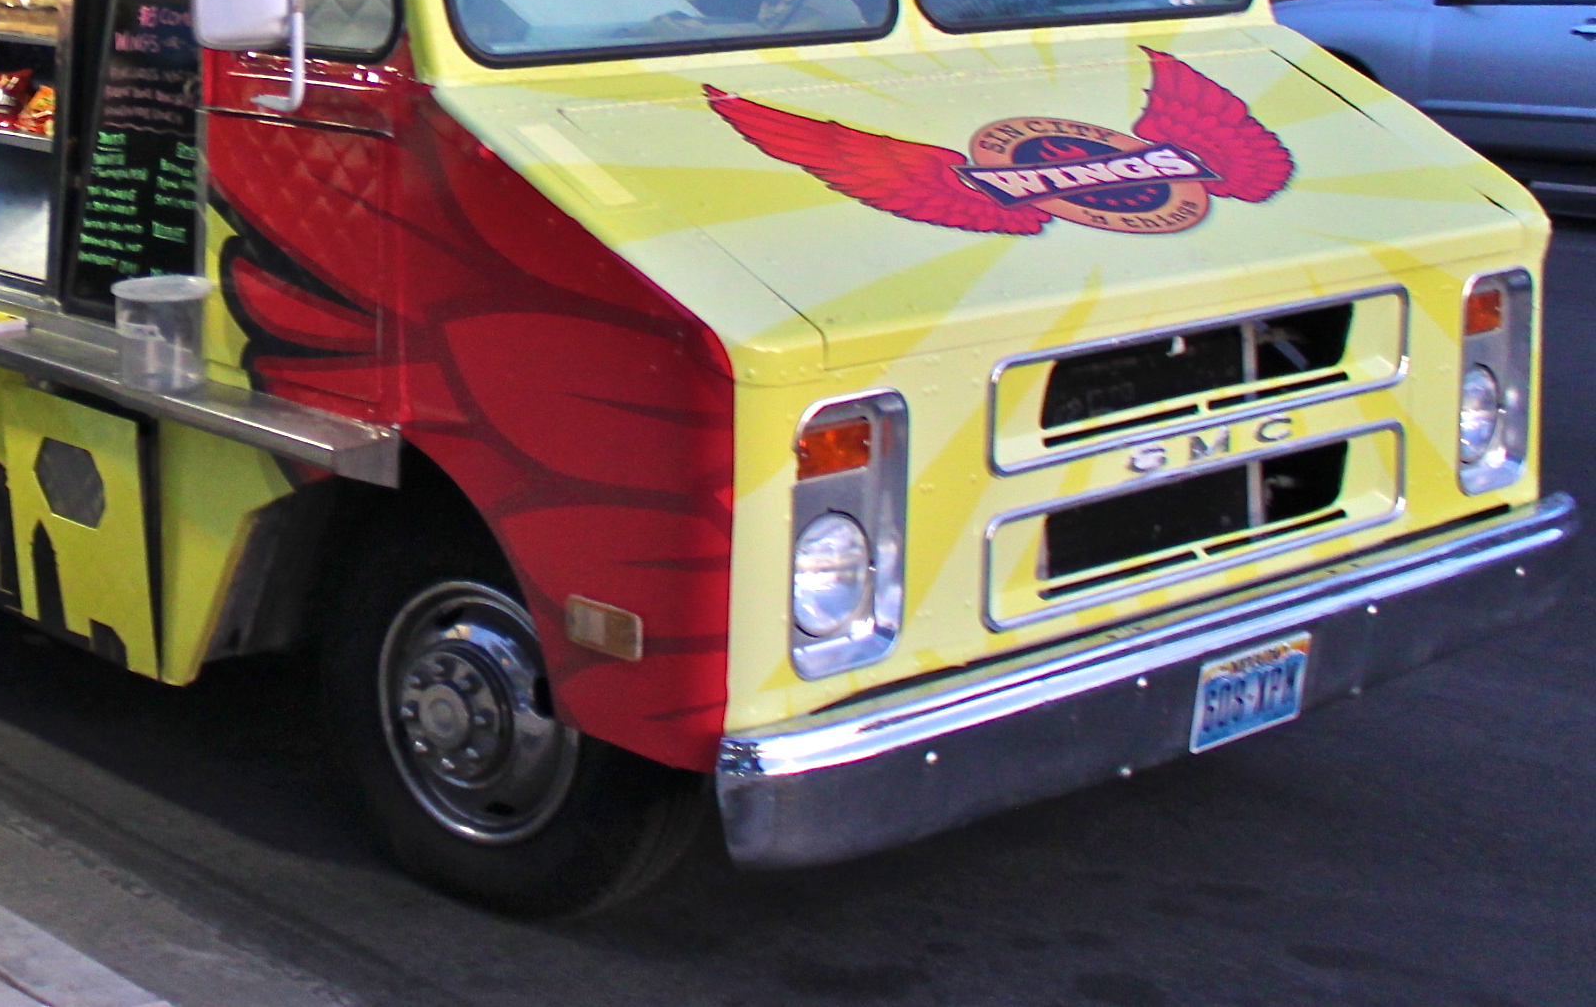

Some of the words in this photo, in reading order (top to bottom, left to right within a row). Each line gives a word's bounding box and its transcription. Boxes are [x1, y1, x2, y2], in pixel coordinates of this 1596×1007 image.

[979, 124, 1024, 154] SIN
[1026, 120, 1117, 143] CITY
[970, 148, 1200, 199] WINGS
[1121, 199, 1200, 229] things
[1126, 411, 1294, 473] GMC
